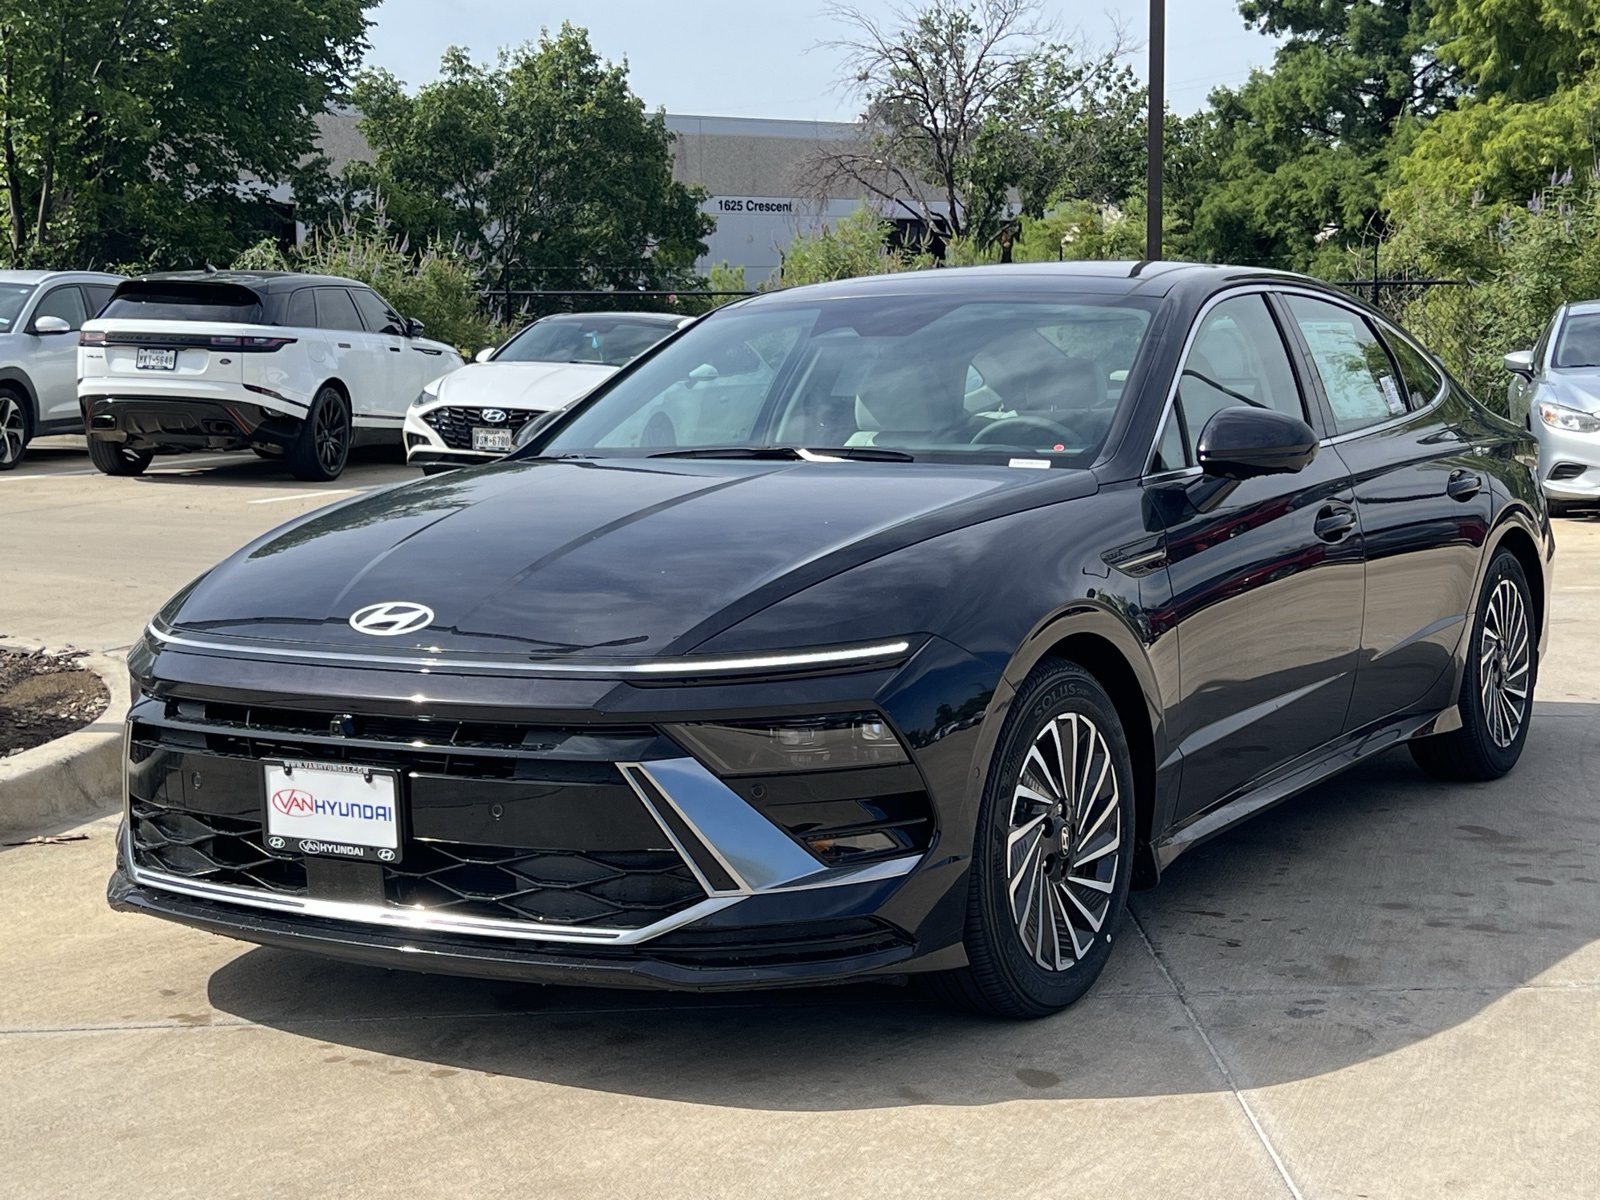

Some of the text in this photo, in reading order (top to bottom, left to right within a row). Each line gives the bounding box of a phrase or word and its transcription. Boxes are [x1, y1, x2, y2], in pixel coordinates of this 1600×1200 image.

[718, 200, 792, 212] 1625 Crescent
[276, 789, 392, 822] VAN HYUNDAI
[302, 841, 364, 857] VAN HYUNDAI
